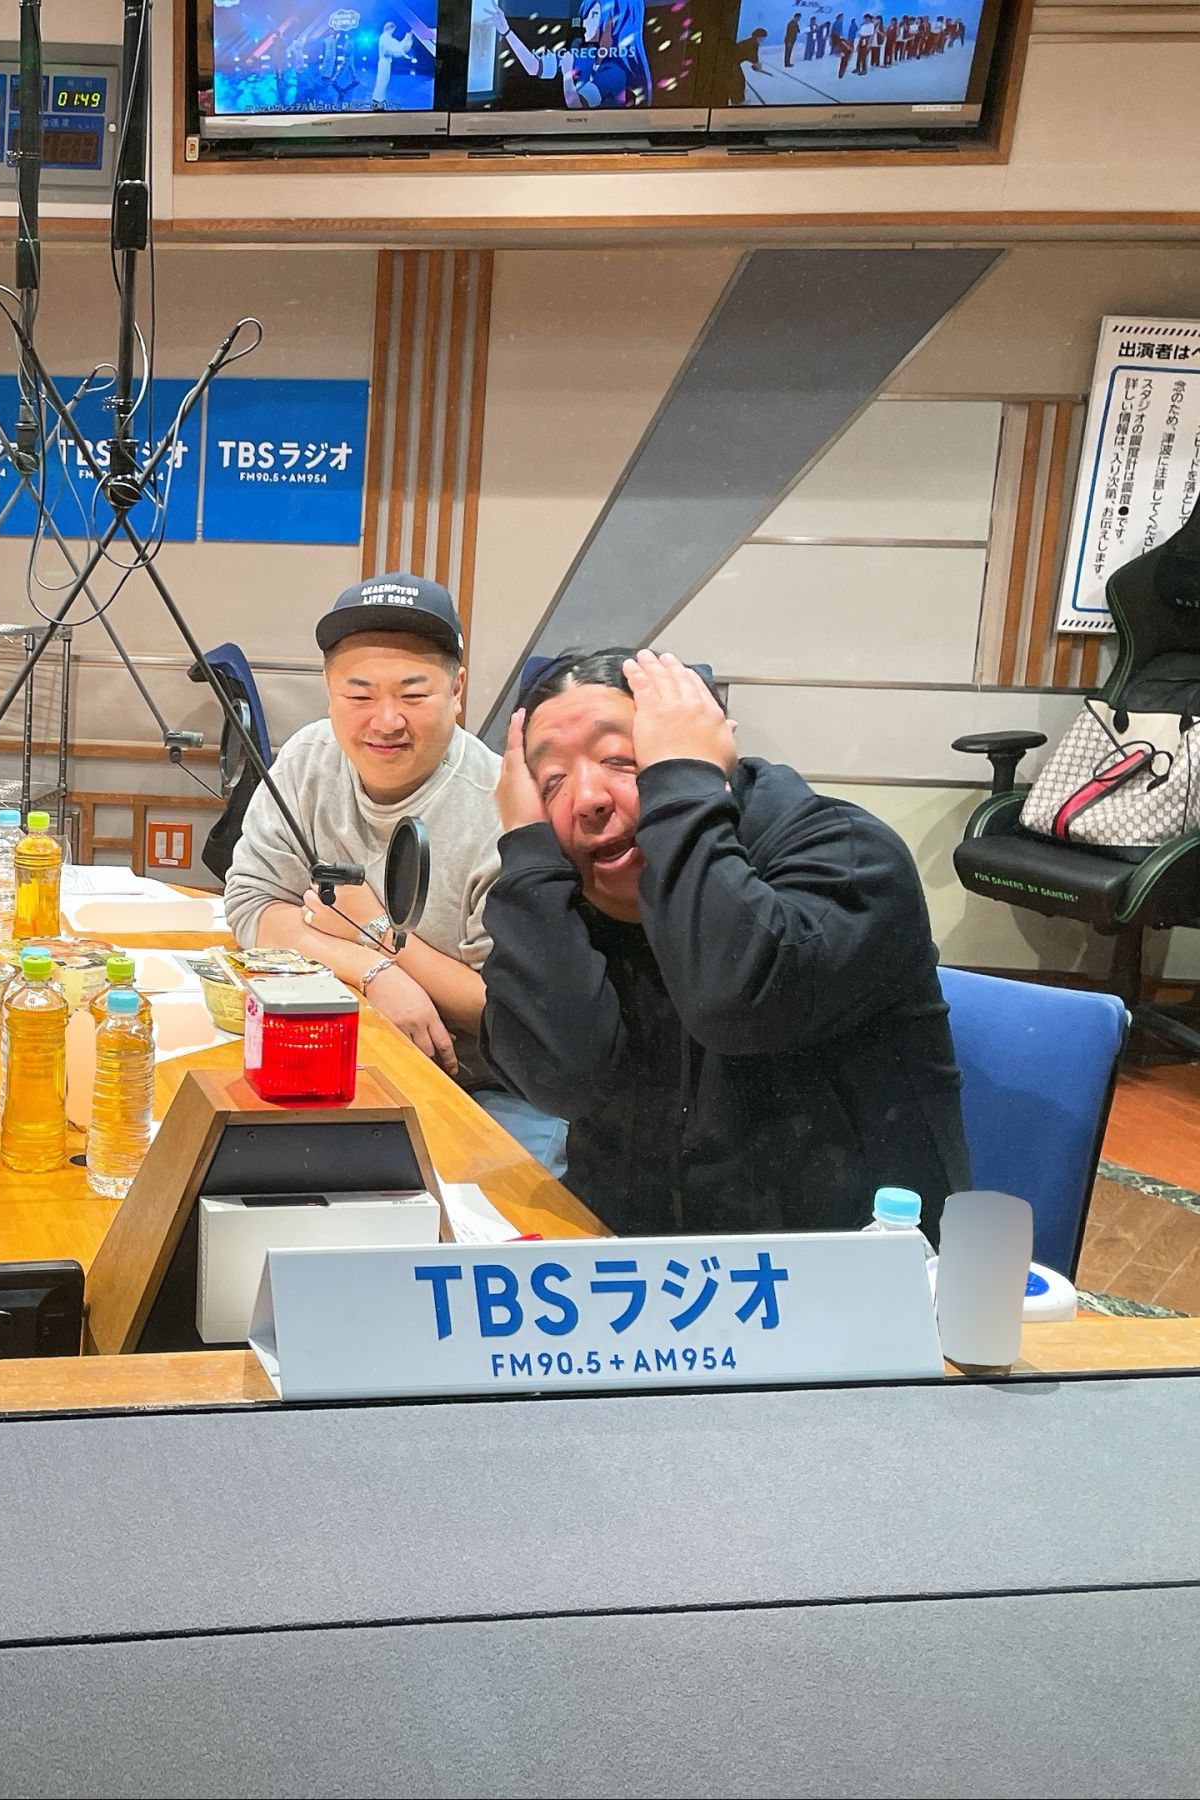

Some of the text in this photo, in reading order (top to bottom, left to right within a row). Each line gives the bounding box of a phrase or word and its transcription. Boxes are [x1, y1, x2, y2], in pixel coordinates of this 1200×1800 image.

[572, 46, 637, 59] RECORDS
[218, 441, 353, 471] TBSラジオ
[363, 594, 414, 605] LIVE 2024
[974, 871, 990, 882] FOR
[1027, 884, 1039, 893] BY
[413, 1252, 790, 1341] TBSラジオ
[490, 1346, 738, 1378] FM90.5+AM954
